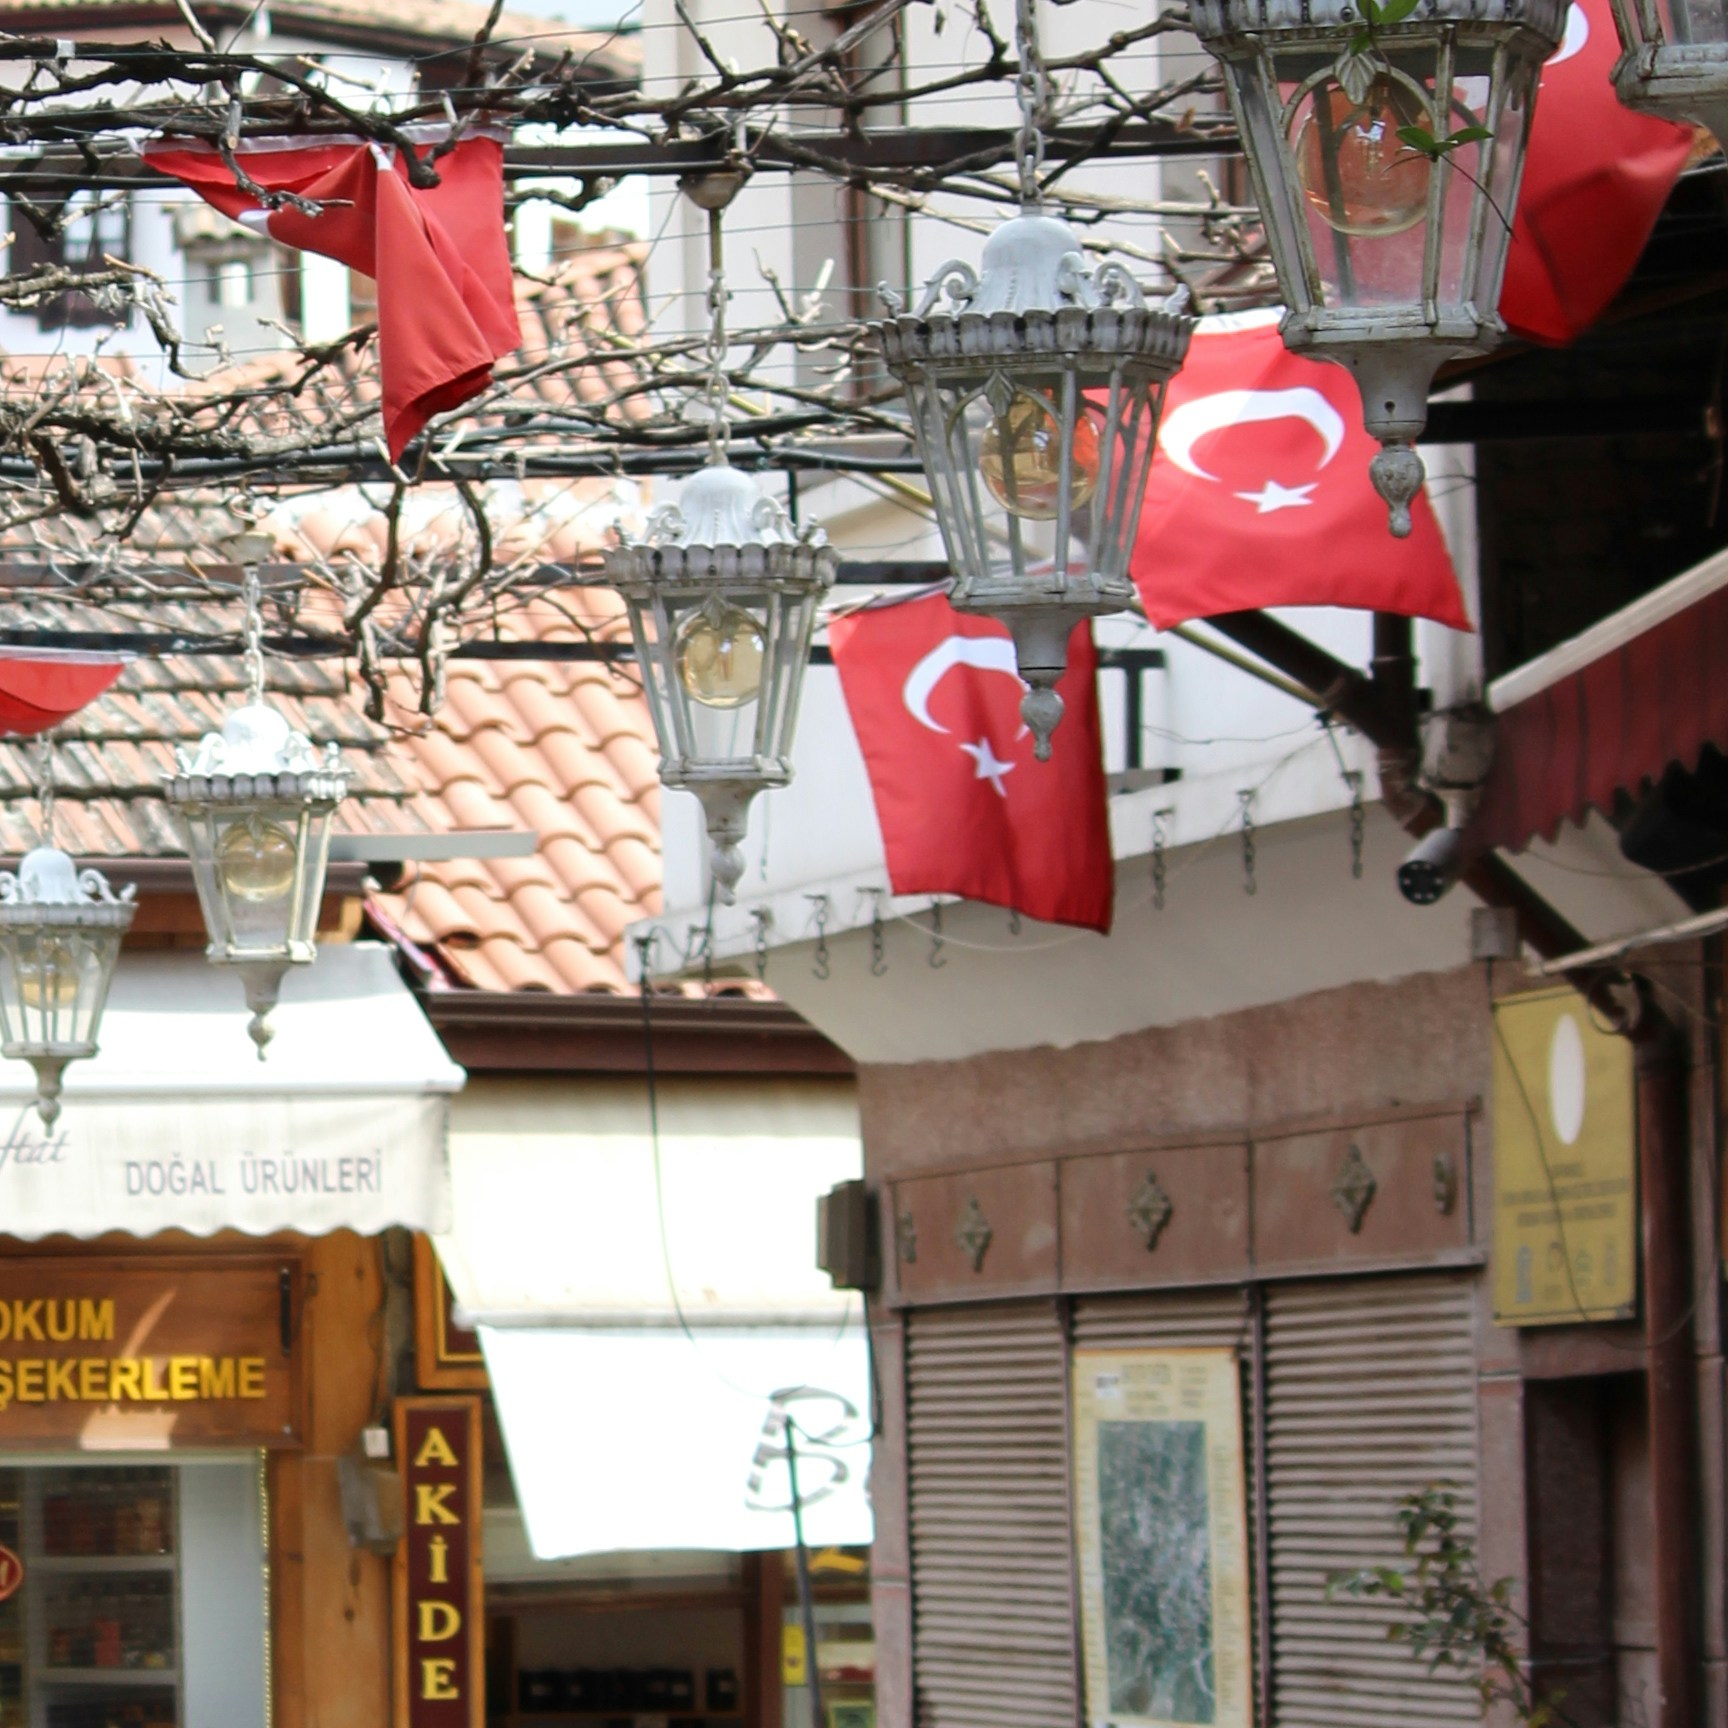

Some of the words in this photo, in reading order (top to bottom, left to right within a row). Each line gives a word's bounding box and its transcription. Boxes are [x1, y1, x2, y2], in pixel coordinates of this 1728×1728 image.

[126, 1154, 226, 1196] DOĞAL
[240, 1149, 383, 1194] ÜRÜNLERİ
[413, 1427, 462, 1700] AKİDE
